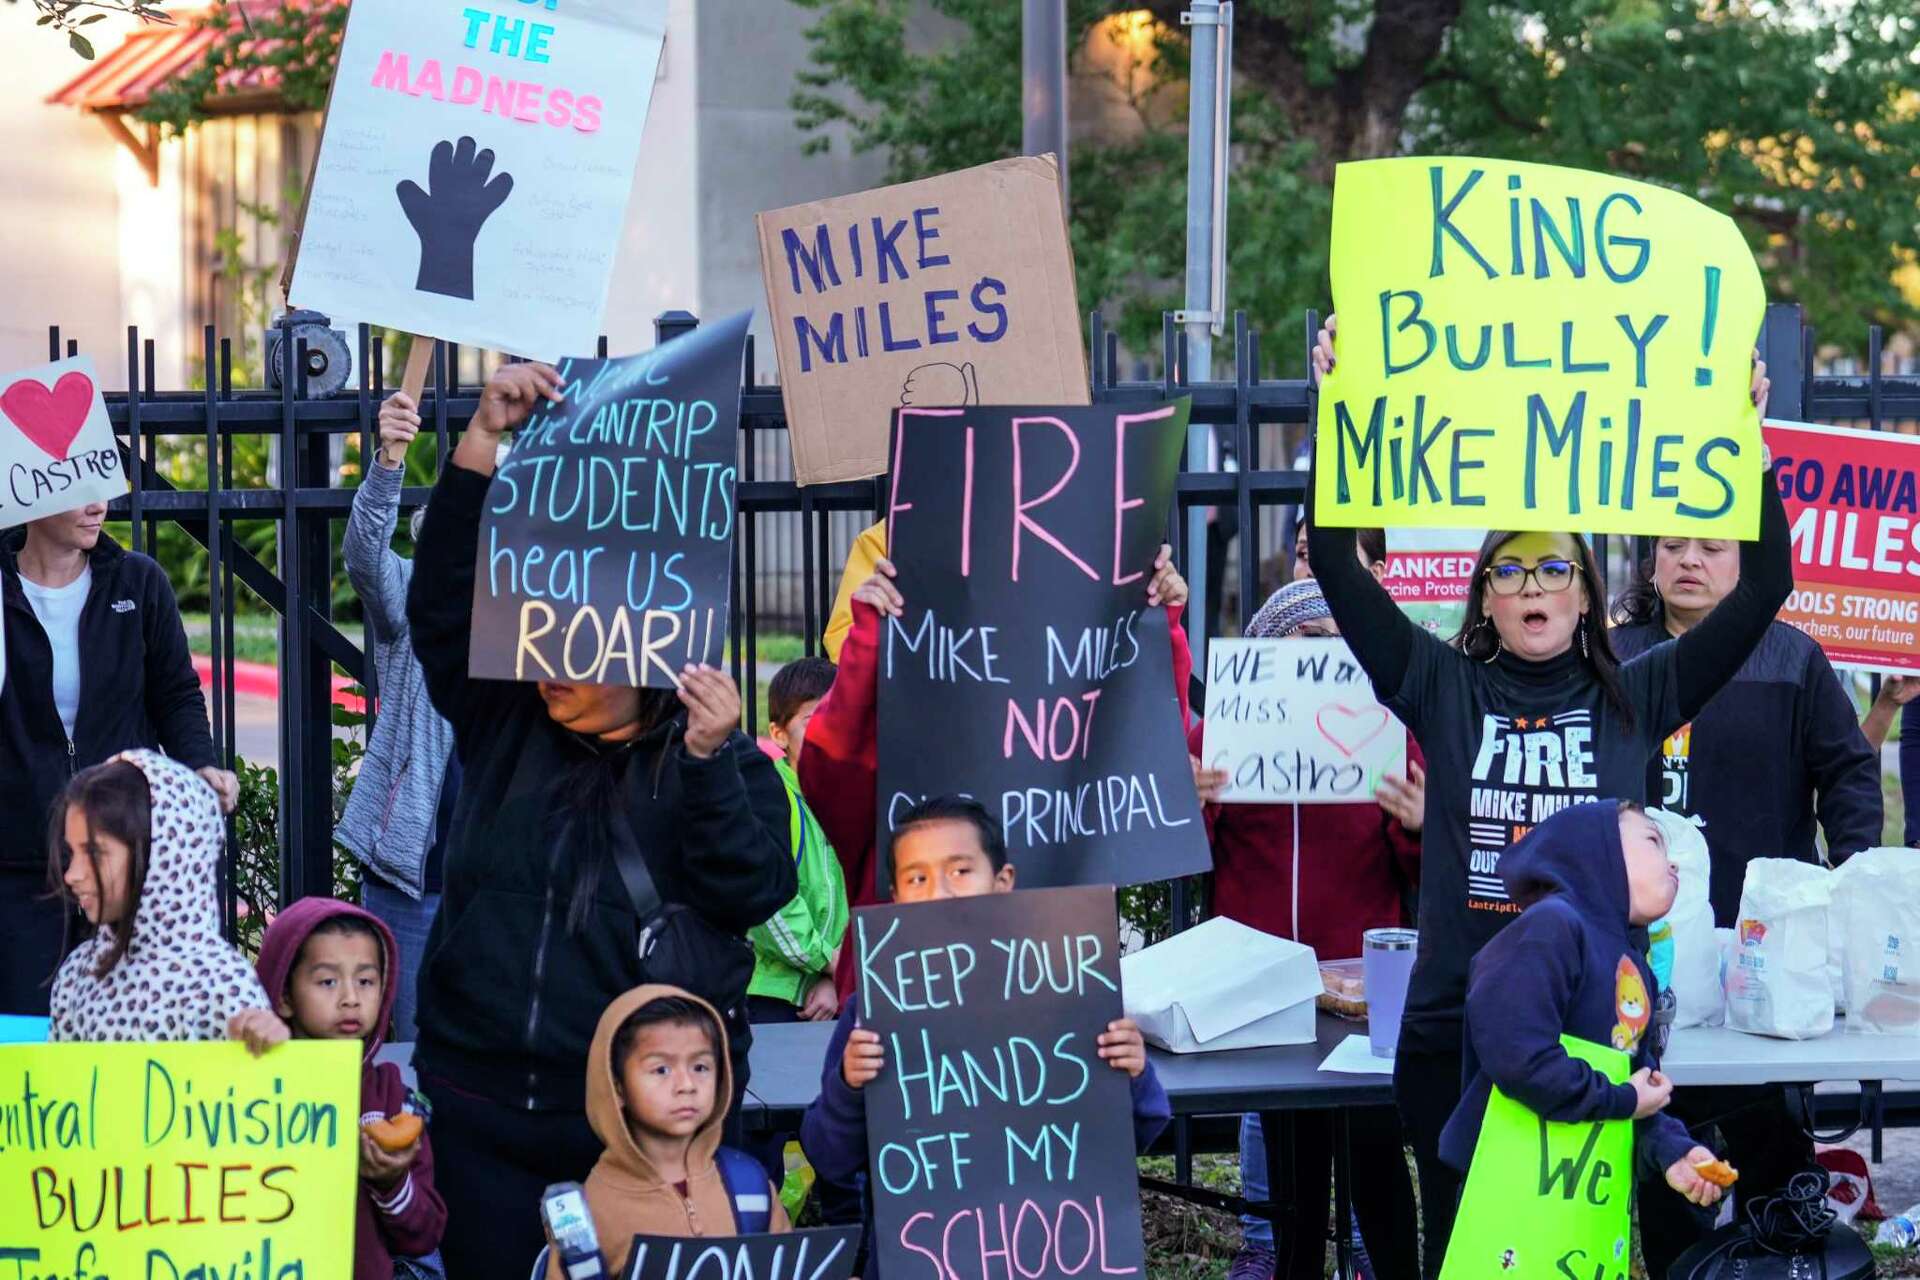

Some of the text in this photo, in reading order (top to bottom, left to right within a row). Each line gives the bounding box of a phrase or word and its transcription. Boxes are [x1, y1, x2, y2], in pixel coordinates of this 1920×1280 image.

[463, 8, 555, 64] THE
[370, 51, 604, 133] MADNESS
[781, 207, 951, 294] MIKE
[793, 277, 1009, 372] MILES
[570, 399, 718, 459] LANTRIP
[9, 449, 118, 507] CASTRO
[491, 455, 737, 541] STUDENTS
[886, 407, 1176, 585] FIRE
[1774, 457, 1918, 514] GO AWA
[490, 527, 604, 603] hear
[1384, 557, 1475, 578] ANKED
[1386, 582, 1470, 596] cine Protec
[1781, 590, 1919, 624] OOLS STRONG
[1782, 618, 1915, 645] achers, our future
[887, 609, 1140, 685] MIKE MILES
[1212, 646, 1371, 685] WE Wa
[1003, 689, 1103, 762] NOT
[1471, 713, 1598, 789] FIRE
[1002, 773, 1192, 849] PRINCIPAL
[1470, 787, 1600, 823] MIKE MIL
[1468, 899, 1523, 914] LantripEl
[857, 916, 1118, 1019] KEEP YOUR
[0, 1058, 338, 1151] ntral Division
[891, 1028, 1090, 1120] HANDS
[878, 1121, 1081, 1195] OFF MY
[1538, 1120, 1613, 1205] We
[32, 1162, 297, 1233] BULLIES
[900, 1195, 1138, 1280] SCHOOL
